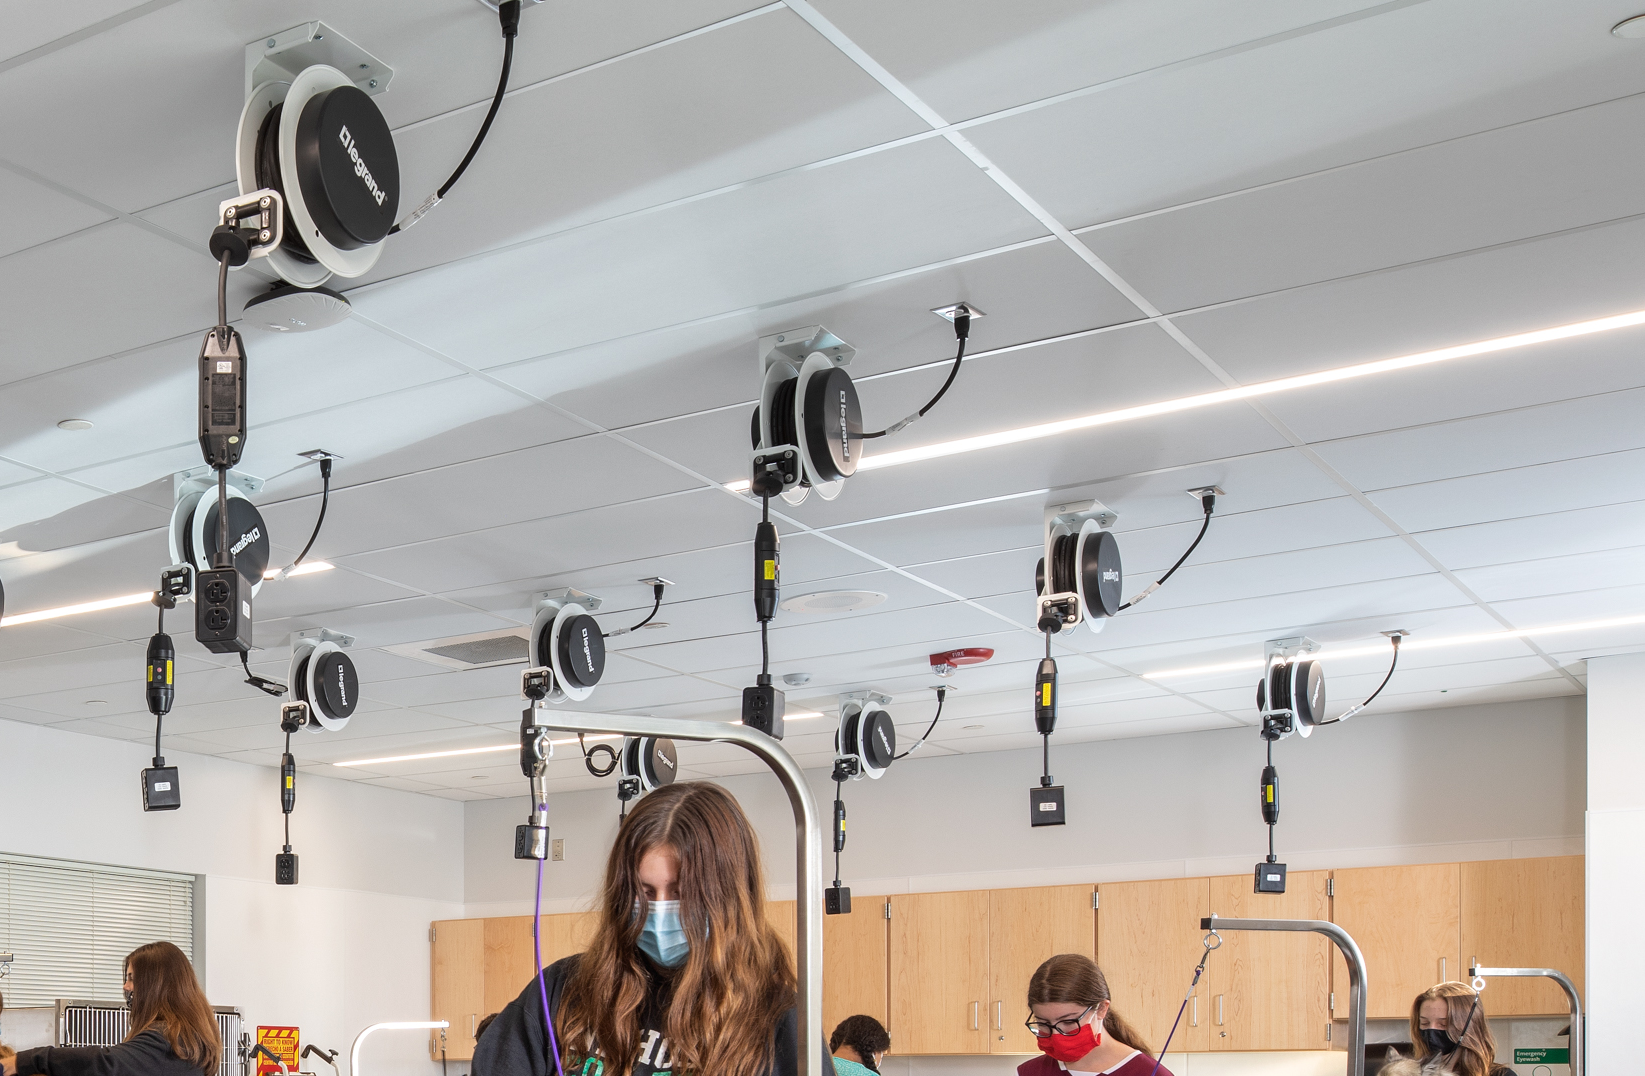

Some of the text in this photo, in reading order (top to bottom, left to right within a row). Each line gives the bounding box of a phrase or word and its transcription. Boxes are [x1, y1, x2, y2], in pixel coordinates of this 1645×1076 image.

[347, 139, 385, 206] legrand
[840, 404, 850, 457] legrand
[230, 531, 255, 555] legrand
[583, 637, 594, 672] legrand
[339, 673, 348, 706] legrand
